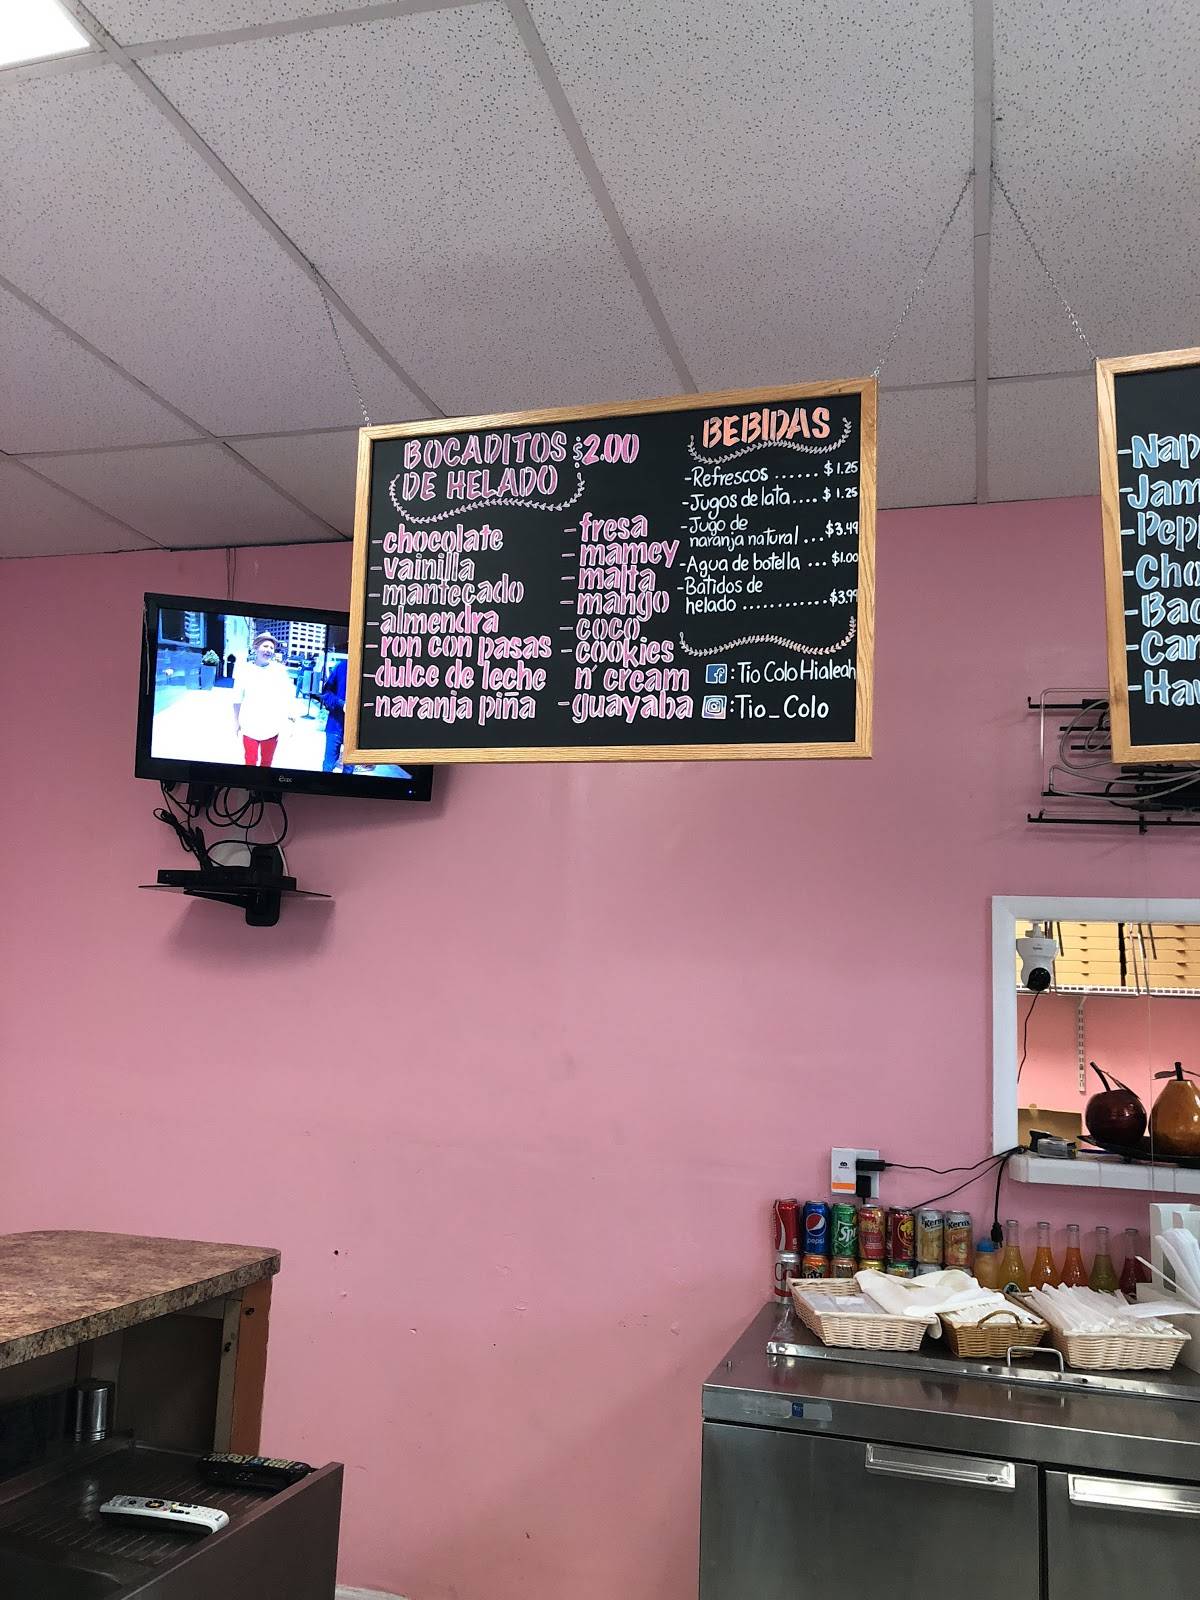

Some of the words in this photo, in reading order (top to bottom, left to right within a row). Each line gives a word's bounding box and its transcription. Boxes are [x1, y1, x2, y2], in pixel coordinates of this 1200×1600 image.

[702, 406, 830, 449] BEBIDAS
[403, 430, 567, 470] BOCADITOS
[573, 433, 640, 469] $2.00
[402, 471, 437, 501] DE
[446, 465, 559, 500] HELADO
[741, 487, 759, 508] de
[730, 513, 749, 531] de
[689, 531, 745, 552] naranja
[748, 525, 799, 546] natural
[824, 519, 859, 539] $3.49
[732, 553, 750, 572] de
[753, 551, 801, 571] botella
[831, 550, 859, 567] $1.00
[746, 574, 764, 593] de
[685, 596, 737, 615] helado
[427, 635, 473, 658] con
[477, 635, 552, 667] pasas
[444, 658, 475, 690] de
[481, 659, 548, 692] leche
[603, 667, 690, 693] cream
[806, 1237, 826, 1247] pepsi
